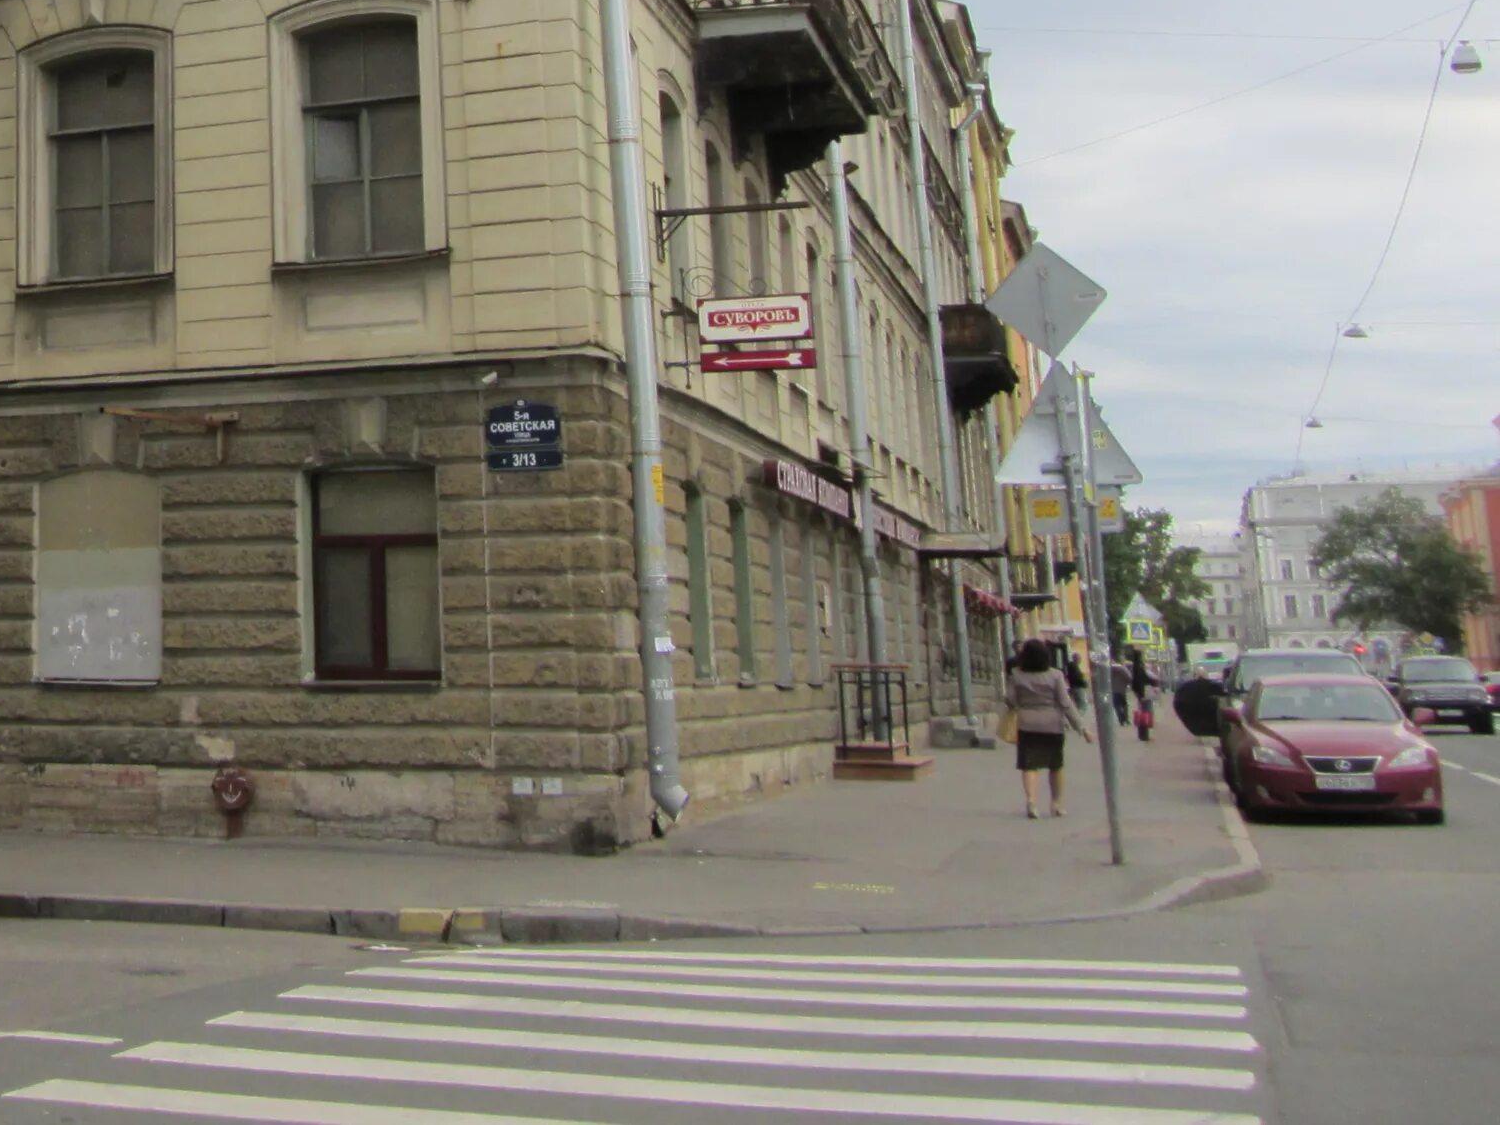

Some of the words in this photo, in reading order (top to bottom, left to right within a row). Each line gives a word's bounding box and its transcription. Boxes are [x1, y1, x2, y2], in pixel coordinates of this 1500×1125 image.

[713, 309, 795, 325] СУВОРОВЪ
[490, 420, 555, 433] СОВЕТСКАЯ
[512, 453, 537, 467] 3/13
